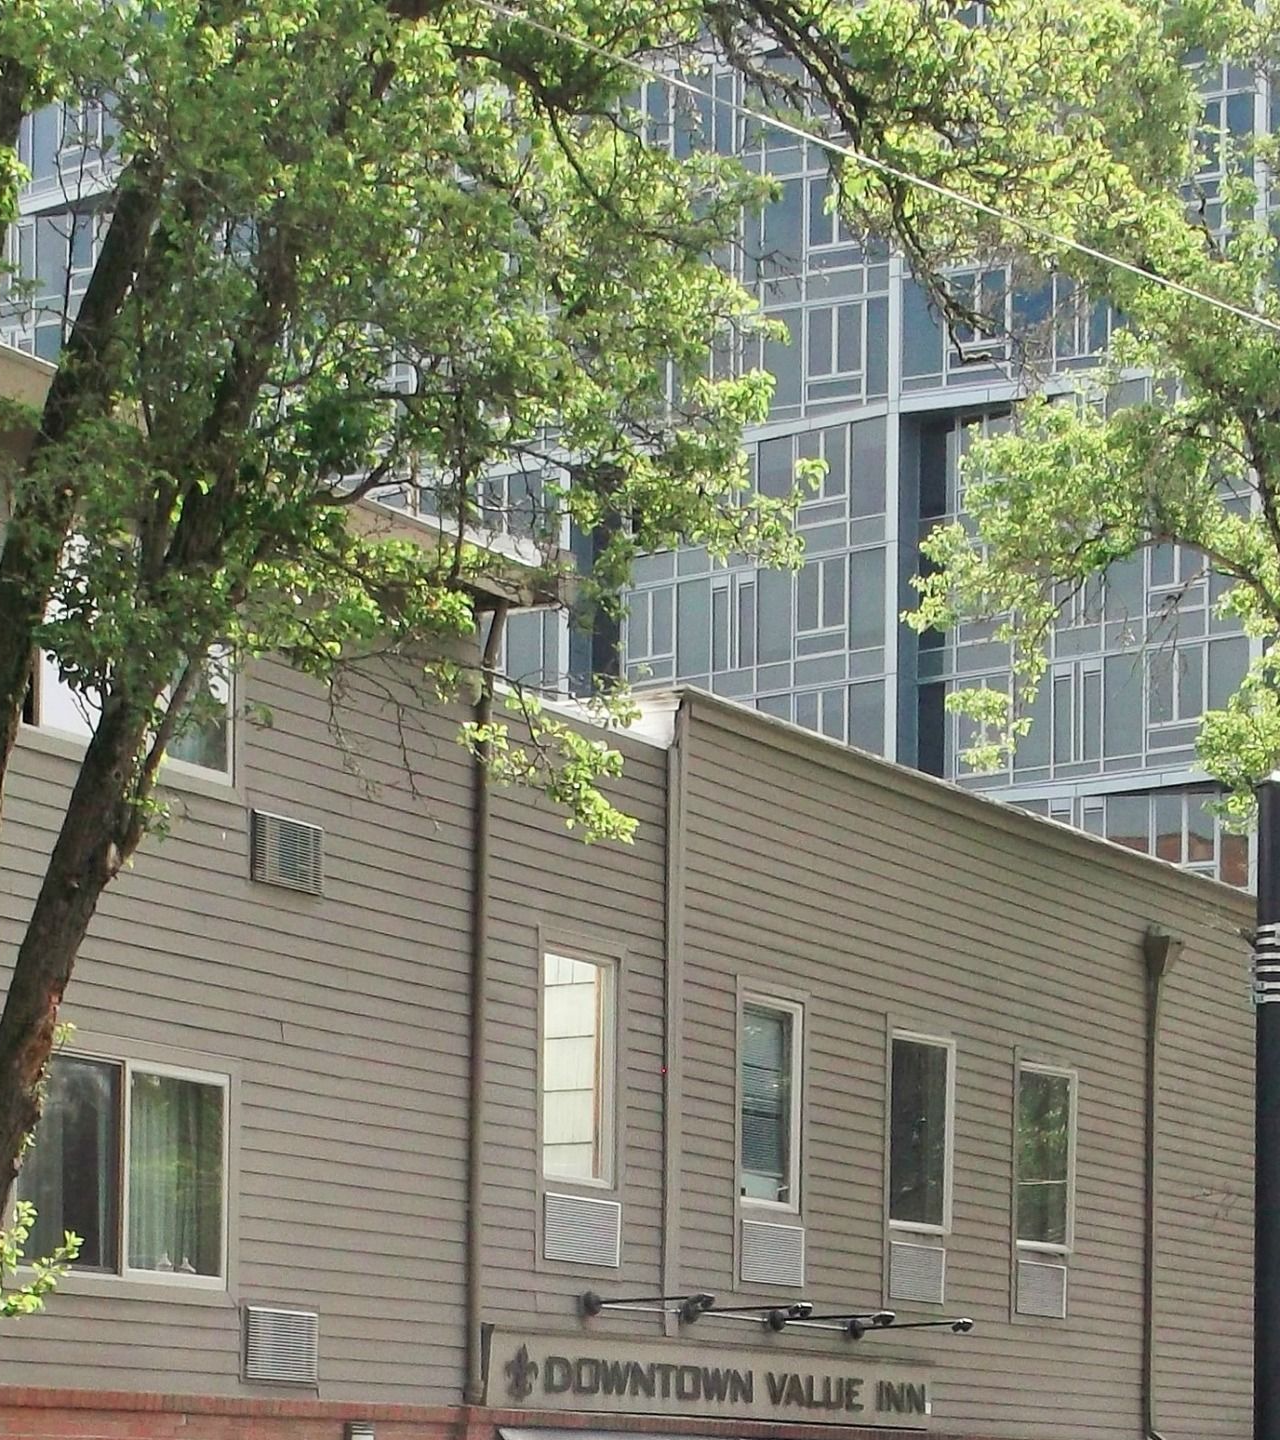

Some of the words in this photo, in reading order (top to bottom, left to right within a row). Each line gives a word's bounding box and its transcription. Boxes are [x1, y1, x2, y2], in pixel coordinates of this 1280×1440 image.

[545, 1356, 753, 1402] DOWNTOWN
[769, 1372, 864, 1410] VALUE
[877, 1380, 926, 1414] INN
